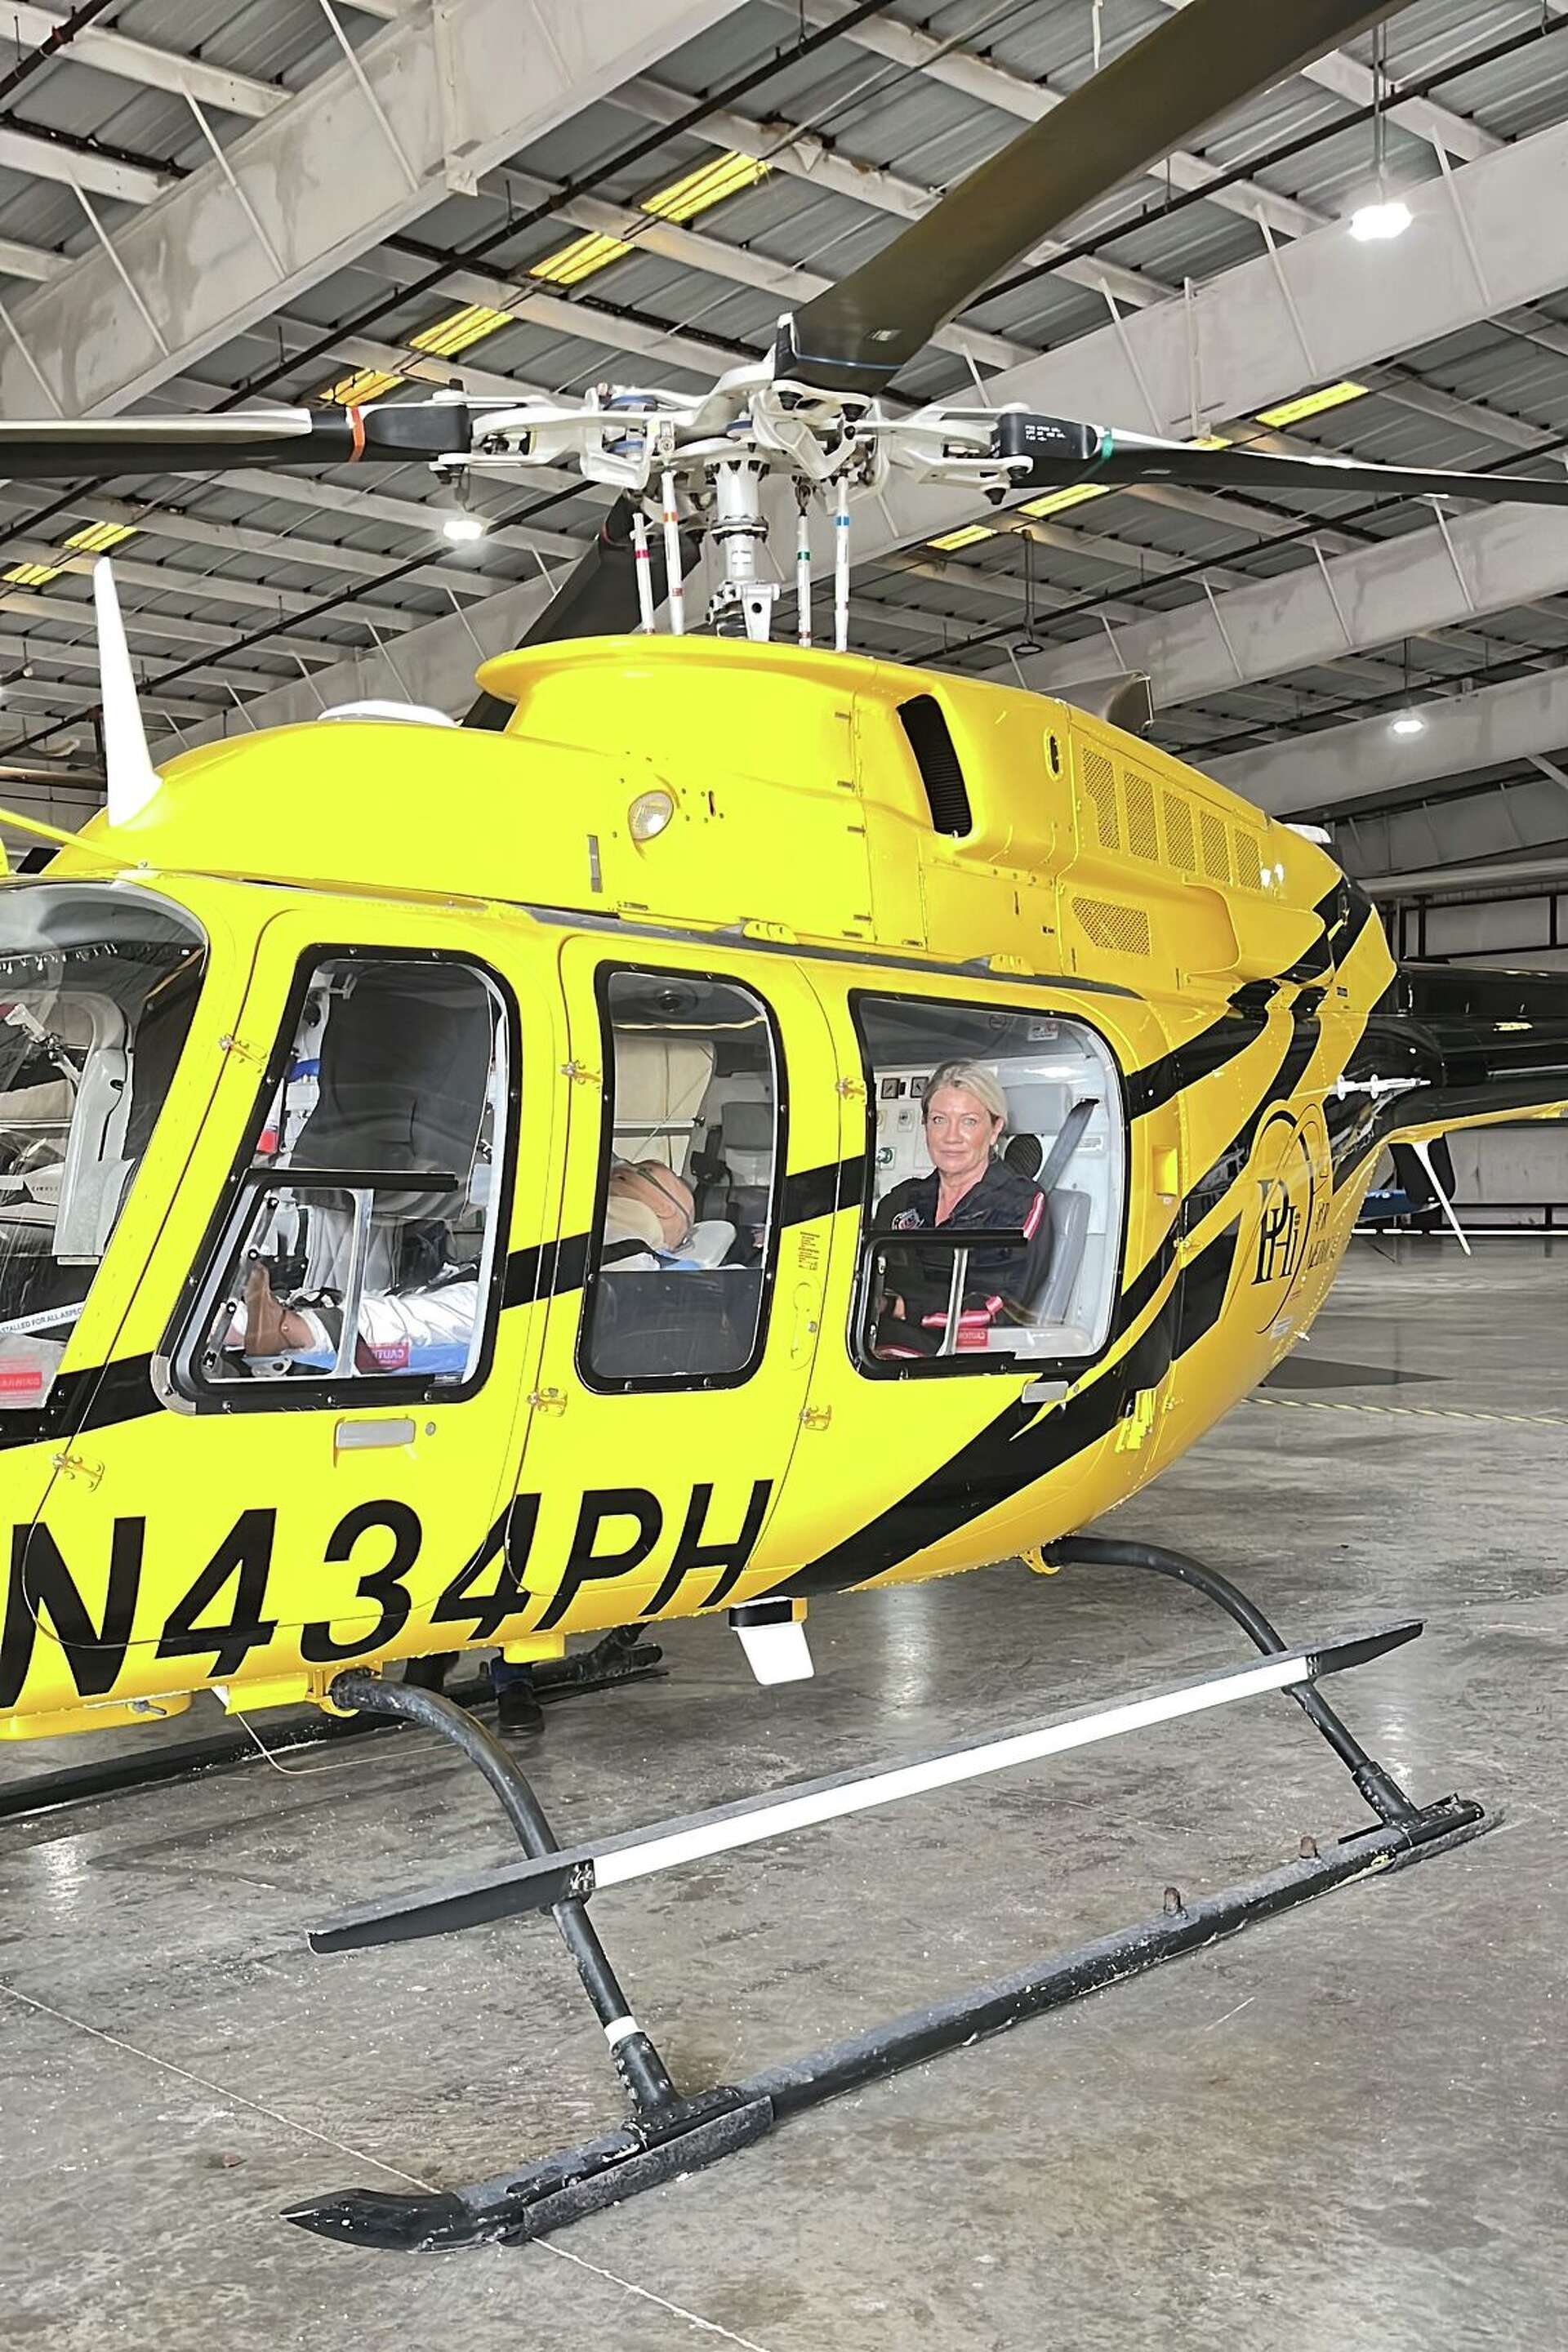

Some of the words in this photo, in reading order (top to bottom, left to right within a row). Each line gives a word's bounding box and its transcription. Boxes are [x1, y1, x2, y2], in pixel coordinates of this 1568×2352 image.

[32, 1316, 46, 1326] FOR
[47, 1312, 59, 1322] ALL
[0, 1479, 774, 1708] N434PH
